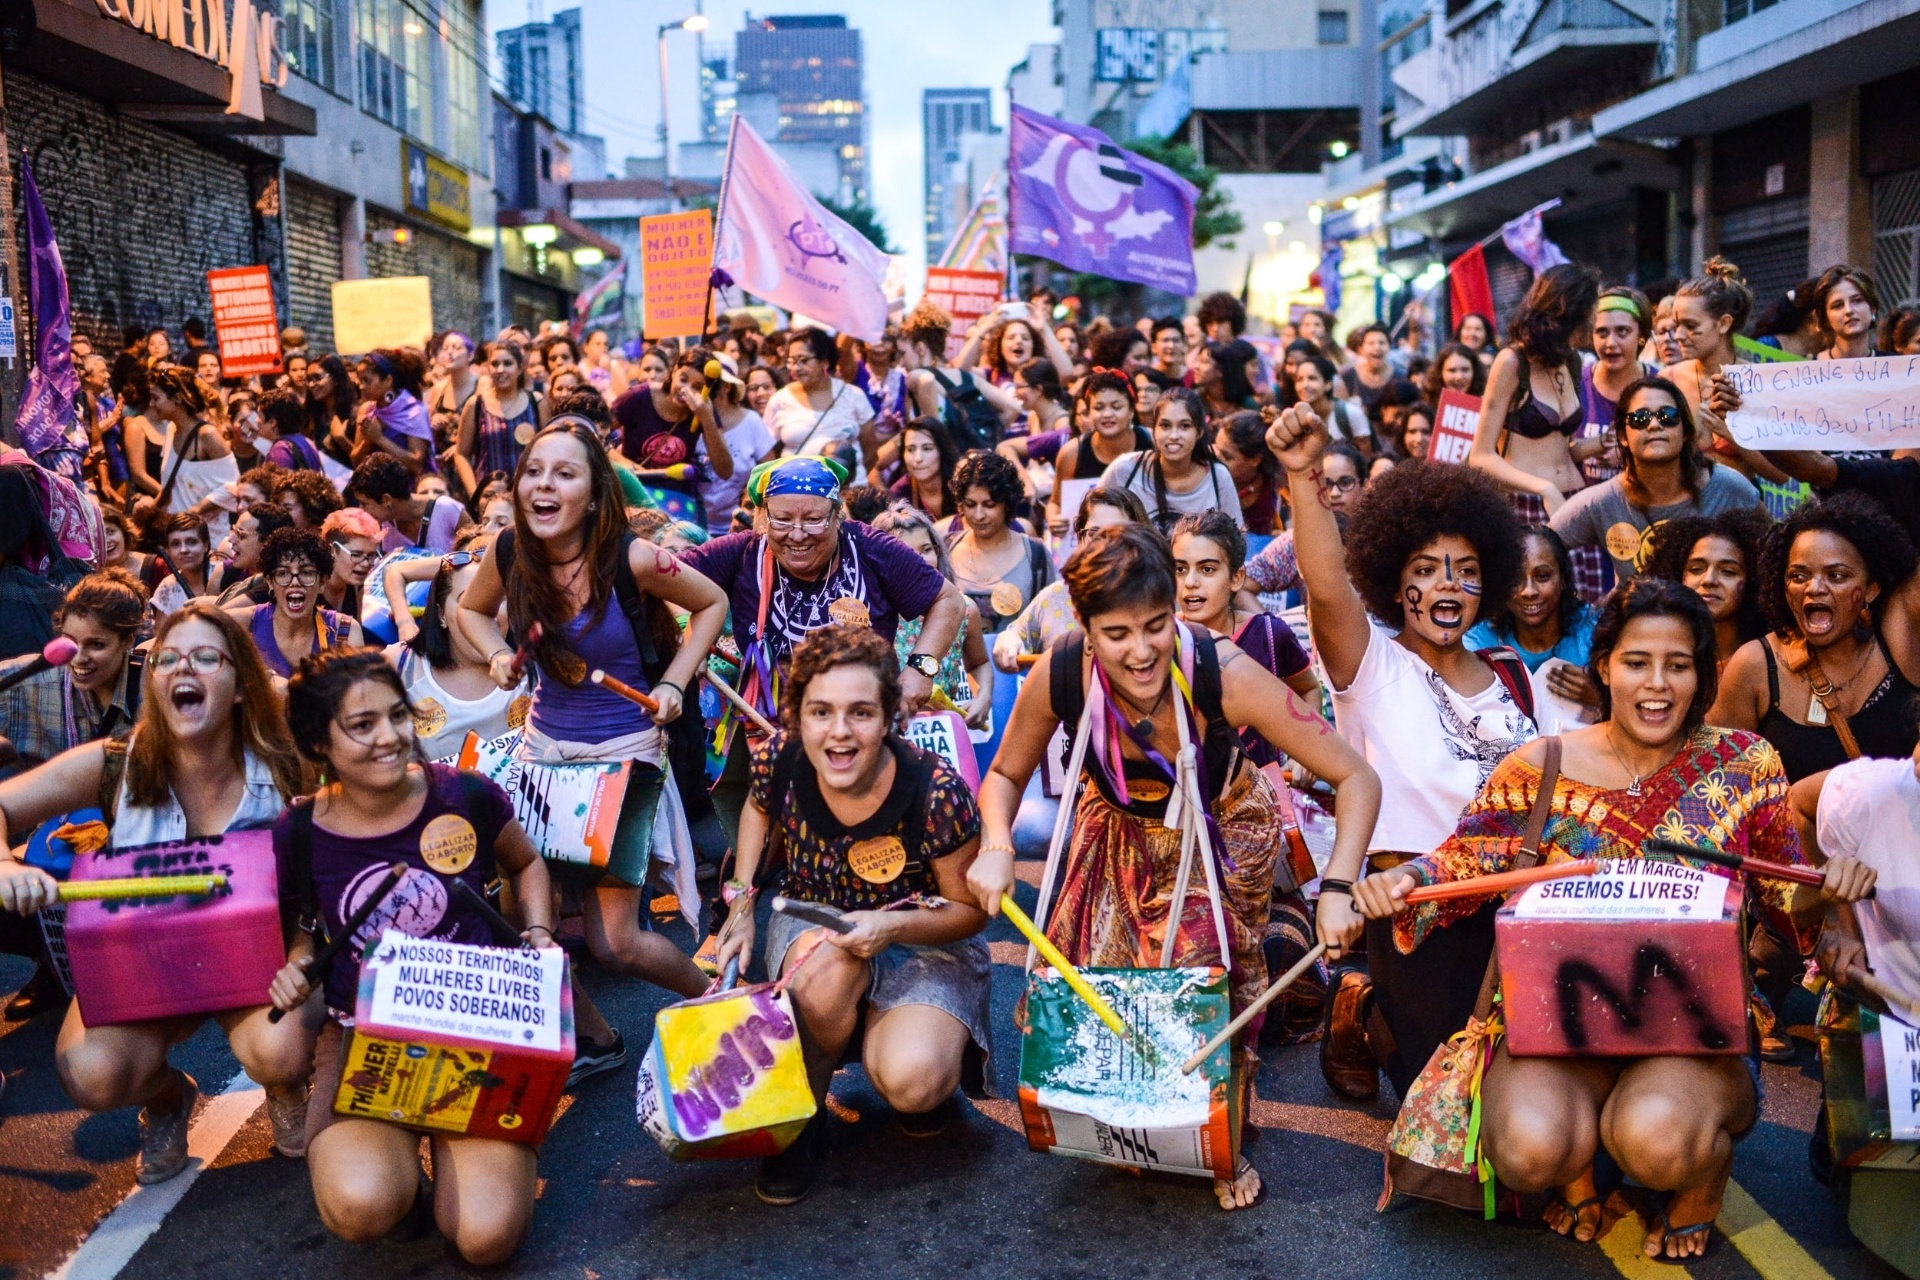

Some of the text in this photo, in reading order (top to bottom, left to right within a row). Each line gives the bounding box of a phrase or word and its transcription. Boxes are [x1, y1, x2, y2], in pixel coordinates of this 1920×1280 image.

[96, 0, 288, 121] MEDIANS
[646, 218, 705, 233] MULHER
[648, 248, 707, 262] OBJETO
[223, 336, 278, 359] ABORTO
[1441, 403, 1481, 436] NEM
[598, 779, 606, 794] COLA
[587, 806, 600, 838] CONTATO
[422, 832, 476, 853] LEGALIZAR
[427, 843, 476, 862] O ABORTO
[850, 845, 903, 868] LEGALIZAR
[857, 853, 904, 875] O ABORTO
[1616, 859, 1639, 876] EM
[1641, 860, 1704, 883] MARCHA
[1540, 880, 1700, 900] SEREMOS LIVRES!
[1535, 903, 1666, 915] marcha mundial das mulheres
[399, 944, 453, 965] NOSSOS
[457, 950, 544, 984] TERRITÓRIOS!
[399, 965, 541, 1004] MULHERES LIVRES
[1555, 939, 1732, 1052] M
[393, 985, 546, 1026] POVOS SOBERANOS!
[391, 1010, 513, 1040] marcha mundial das mulheres
[378, 1043, 402, 1096] NATRIELLI
